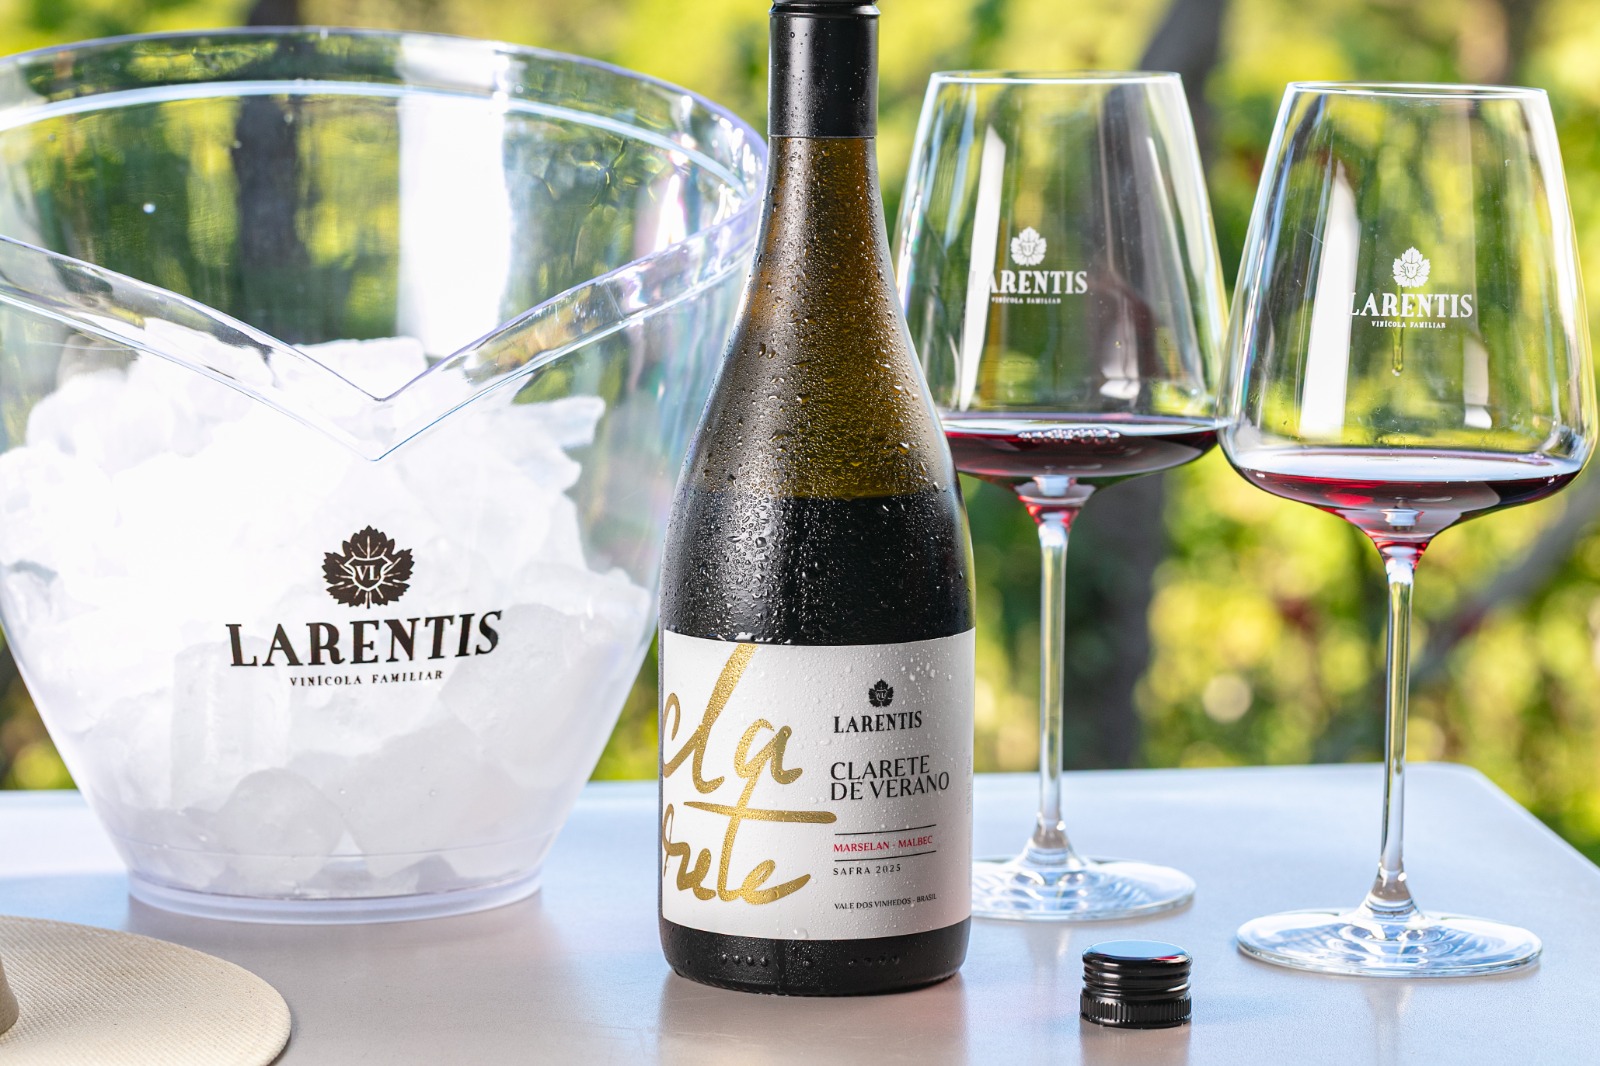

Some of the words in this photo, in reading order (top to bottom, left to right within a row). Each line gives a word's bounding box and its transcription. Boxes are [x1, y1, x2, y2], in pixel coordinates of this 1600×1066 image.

[1349, 292, 1473, 318] LARENTIS
[355, 565, 380, 581] VL
[225, 610, 504, 668] LARENTIS
[290, 674, 362, 687] VINÍCOLA
[372, 670, 444, 685] FAMILIAR
[834, 710, 922, 734] LARENTIS
[830, 755, 930, 781] CLARETE
[831, 781, 863, 801] DE
[869, 771, 949, 799] VERANO
[833, 841, 890, 853] MARSELAN
[898, 835, 933, 848] MALBEC
[833, 866, 871, 876] SAFRA
[875, 864, 901, 874] 2025
[834, 902, 855, 910] VALE
[856, 901, 873, 909] DOS
[874, 898, 911, 908] VINHEDOS
[917, 893, 937, 903] BRASIL
